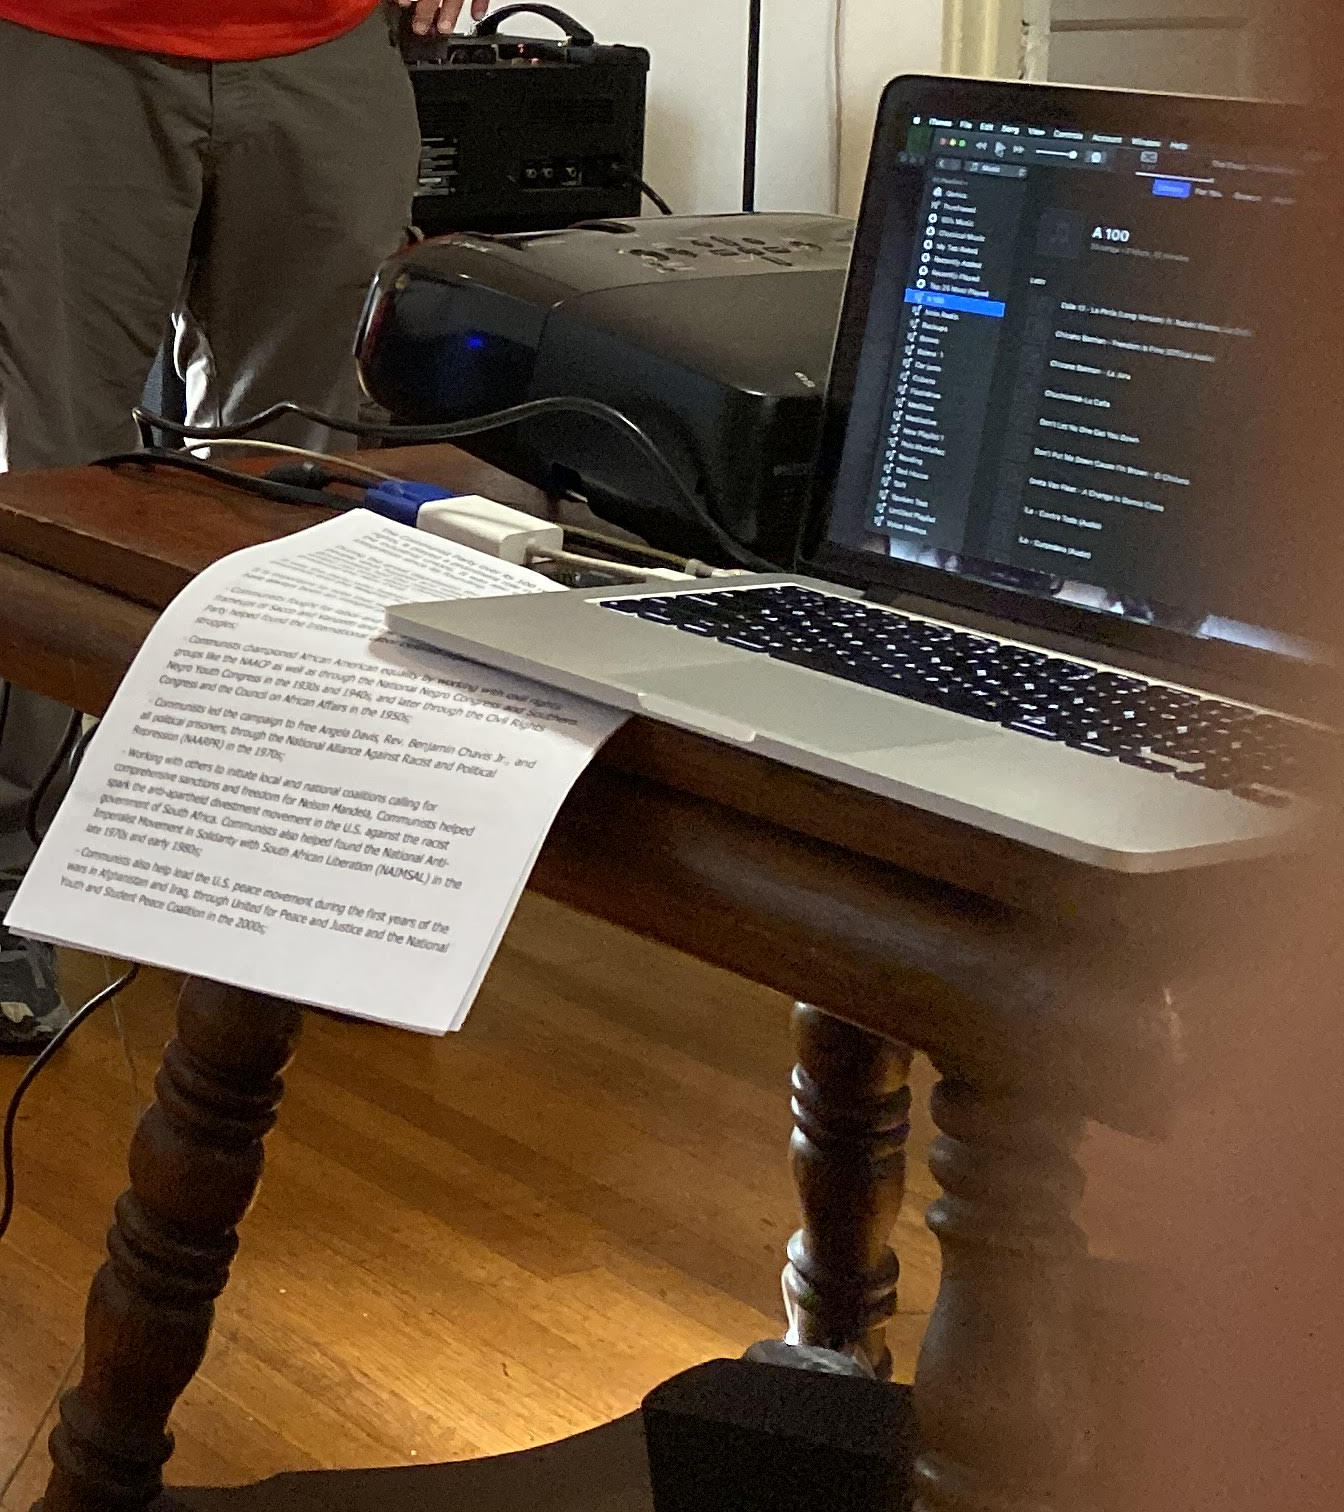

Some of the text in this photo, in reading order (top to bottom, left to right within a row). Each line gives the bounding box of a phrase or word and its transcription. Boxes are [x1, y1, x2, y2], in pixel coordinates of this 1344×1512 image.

[1092, 227, 1130, 242] A 100
[198, 682, 218, 691] and
[218, 684, 234, 693] the
[268, 693, 282, 701] on
[349, 706, 359, 714] in
[360, 707, 378, 717] the
[274, 678, 291, 687] the
[321, 686, 342, 696] and
[375, 695, 397, 705] and
[465, 710, 484, 720] the
[139, 711, 153, 720] all
[268, 733, 285, 743] the
[433, 761, 456, 771] and
[207, 705, 223, 716] led
[222, 708, 239, 719] the
[284, 719, 296, 728] to
[514, 758, 538, 769] and
[225, 742, 236, 751] in
[237, 744, 253, 755] the
[281, 793, 298, 804] for
[282, 779, 303, 788] and
[422, 801, 439, 812] for
[313, 818, 323, 827] in
[324, 819, 342, 830] the
[402, 833, 420, 845] the
[363, 844, 381, 856] the
[431, 875, 443, 885] in
[444, 877, 463, 890] the
[85, 884, 104, 894] and
[206, 911, 217, 921] in
[217, 913, 234, 925] the
[194, 872, 211, 884] the
[347, 905, 365, 917] the
[417, 921, 432, 930] of
[431, 922, 450, 935] the
[263, 905, 278, 917] for
[308, 917, 330, 928] and
[364, 928, 386, 940] and
[386, 932, 404, 944] the
